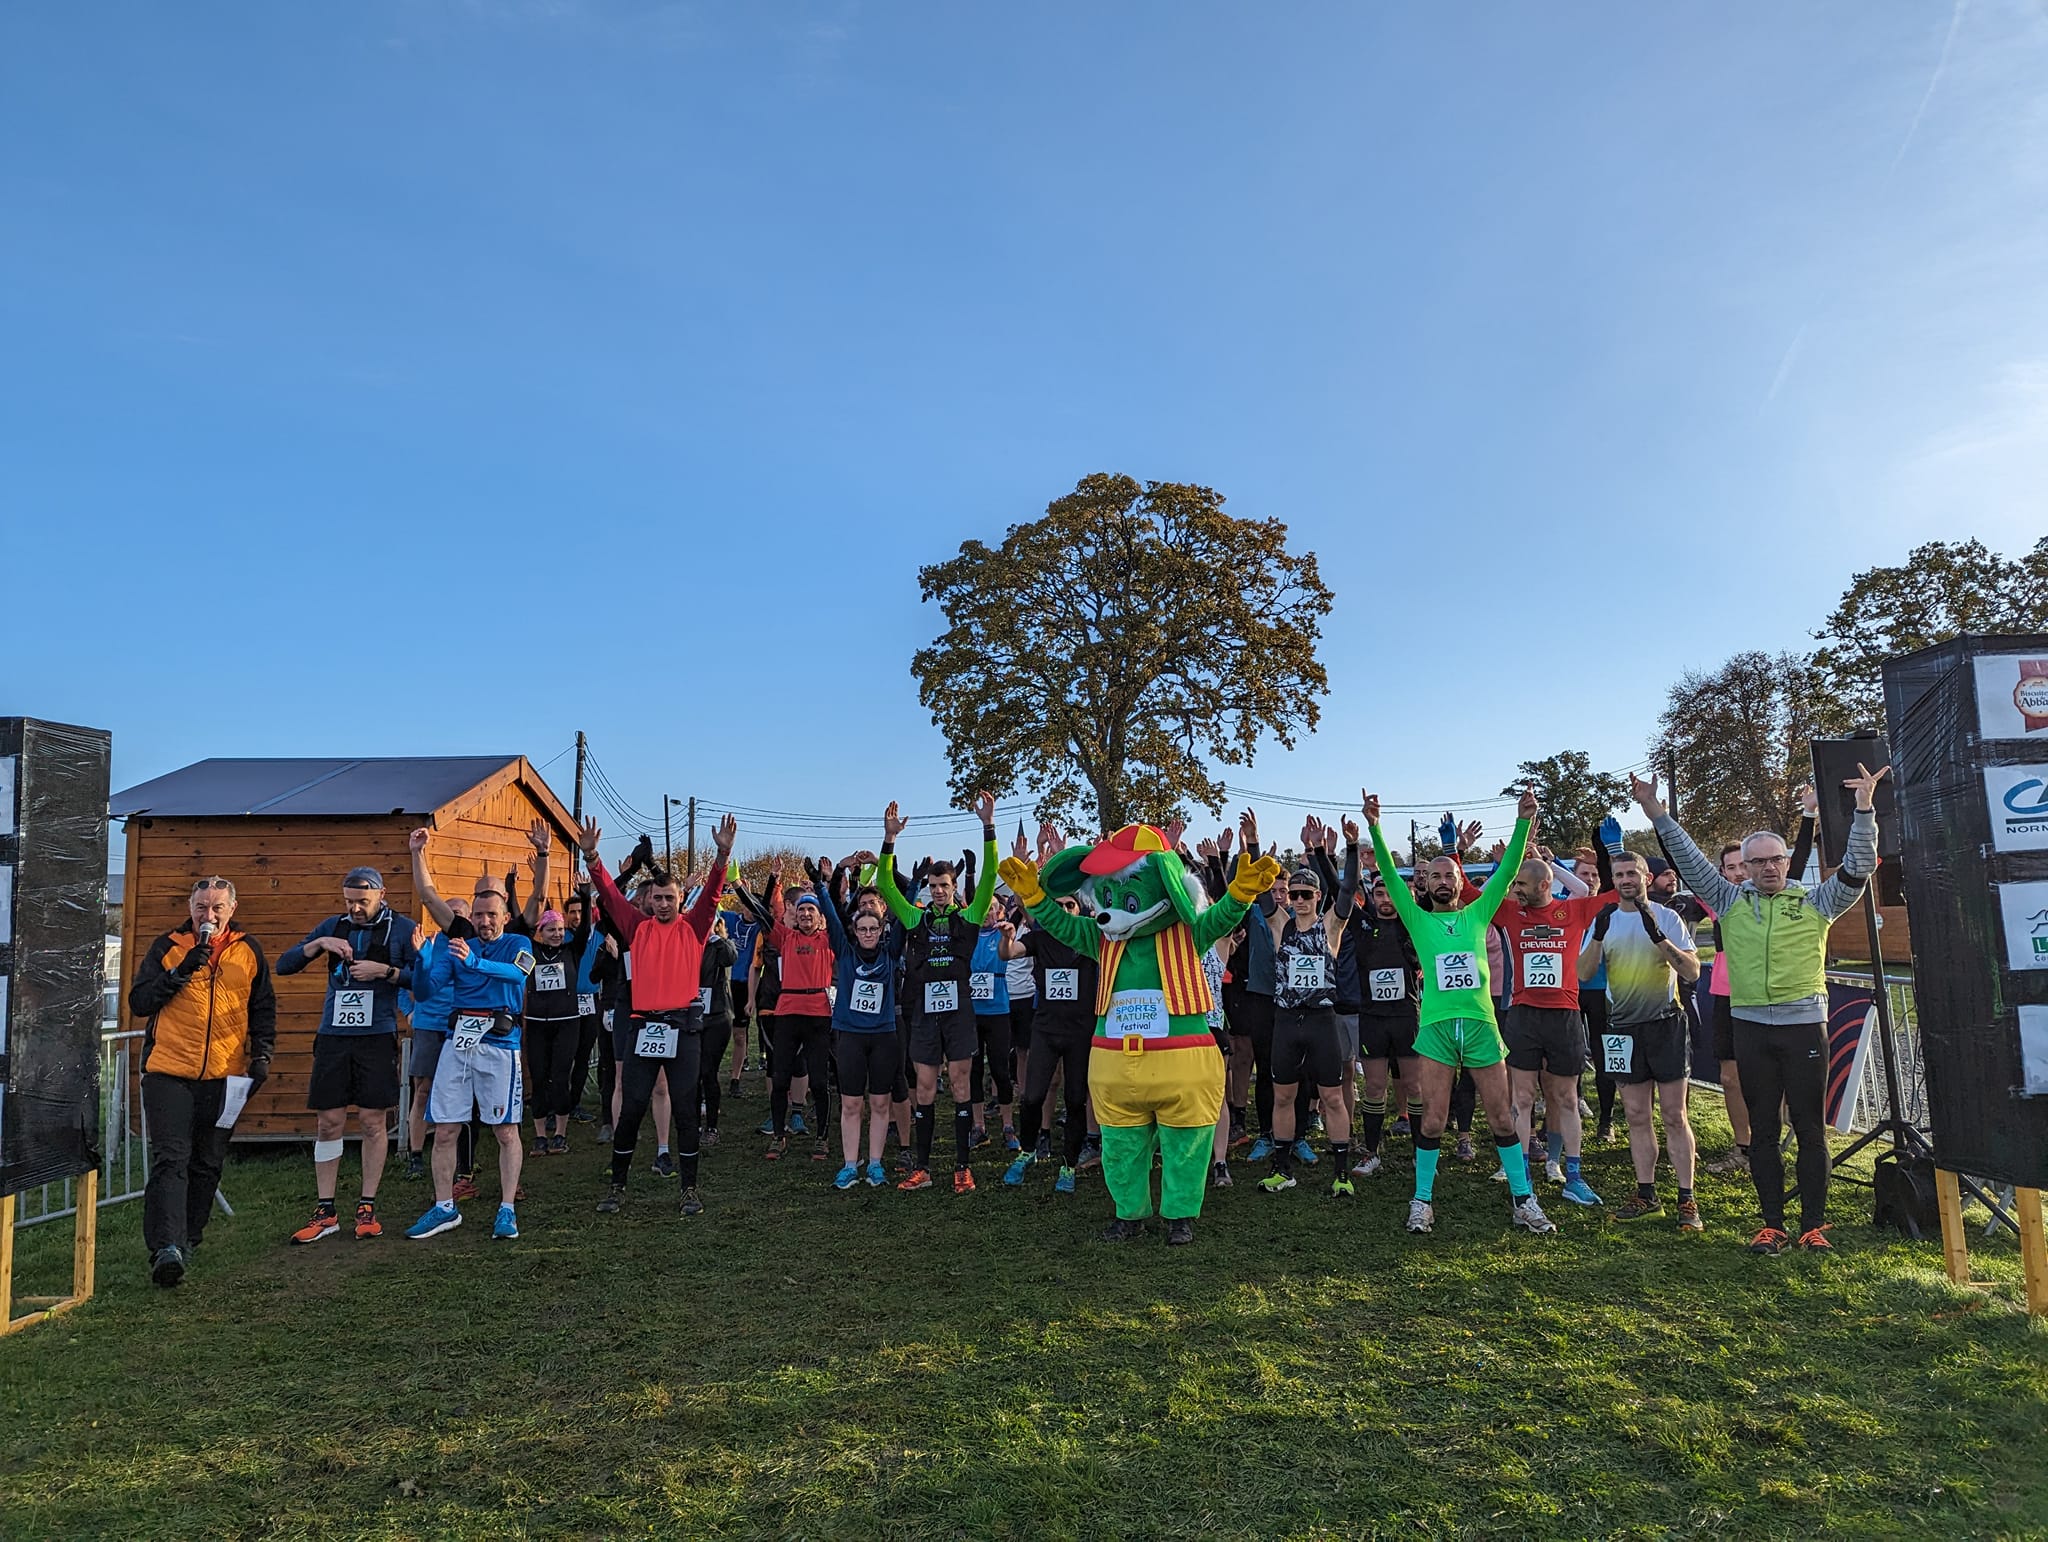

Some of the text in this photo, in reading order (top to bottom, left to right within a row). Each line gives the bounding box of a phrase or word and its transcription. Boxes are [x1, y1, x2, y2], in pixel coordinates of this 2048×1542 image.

[1520, 940, 1568, 949] CHEVROLET
[540, 978, 560, 989] 171
[1294, 974, 1319, 987] 218
[1444, 973, 1473, 988] 256
[1529, 972, 1556, 985] 220
[970, 988, 989, 998] 223
[1049, 987, 1073, 999] 245
[1376, 987, 1400, 999] 207
[855, 999, 876, 1012] 194
[930, 999, 953, 1011] 195
[1111, 996, 1162, 1008] MONTILLY
[1115, 1004, 1157, 1015] SPORTS
[338, 1011, 365, 1025] 263
[1120, 1021, 1151, 1031] festival
[640, 1041, 666, 1054] 285
[1609, 1057, 1625, 1071] 258
